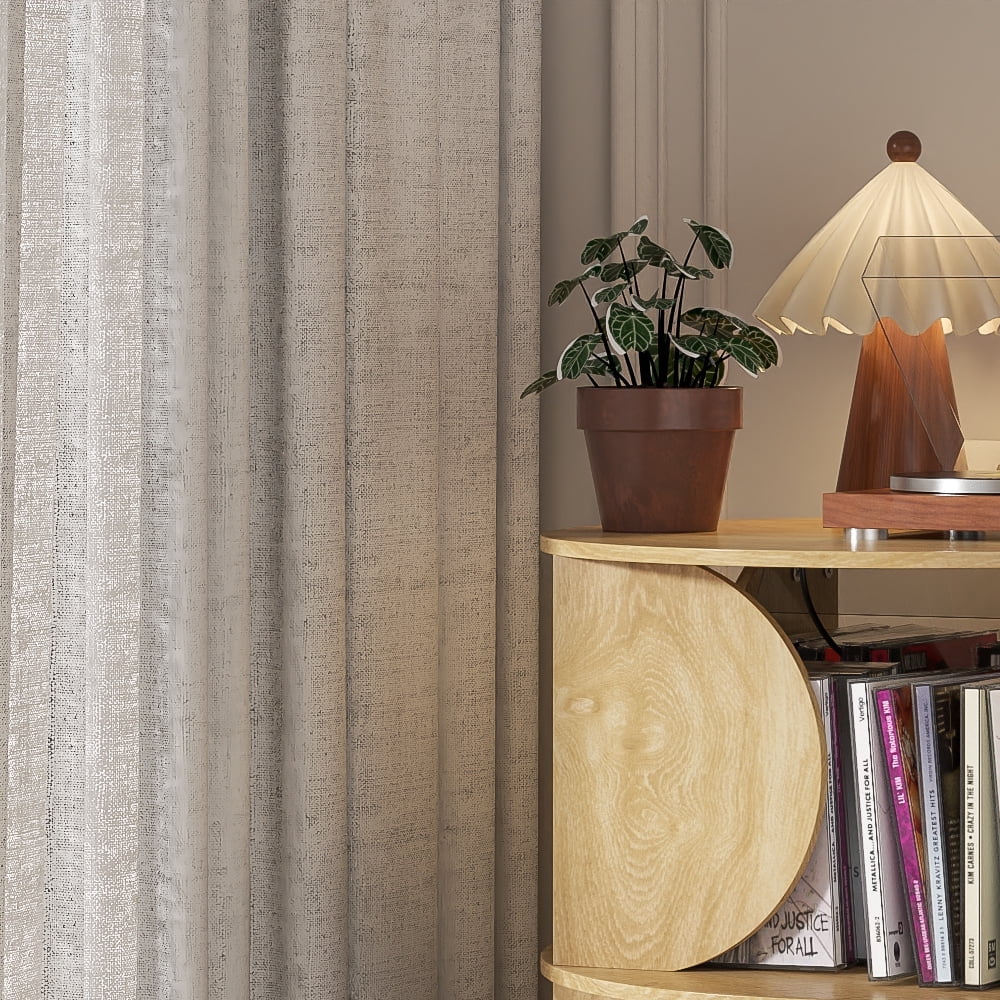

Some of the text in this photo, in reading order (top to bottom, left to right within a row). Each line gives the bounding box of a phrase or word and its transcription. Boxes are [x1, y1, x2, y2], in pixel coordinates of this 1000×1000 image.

[857, 697, 866, 721] Vertigo
[882, 700, 890, 714] KIM
[884, 715, 897, 753] Notorious
[890, 754, 899, 768] The
[894, 776, 903, 790] KIM
[865, 792, 873, 822] JUSTICE
[931, 811, 939, 852] GREATEST
[934, 856, 942, 890] KRAVITZ
[764, 913, 780, 929] ND
[780, 908, 829, 932] JUSTICE
[771, 936, 818, 956] FOR ALL
